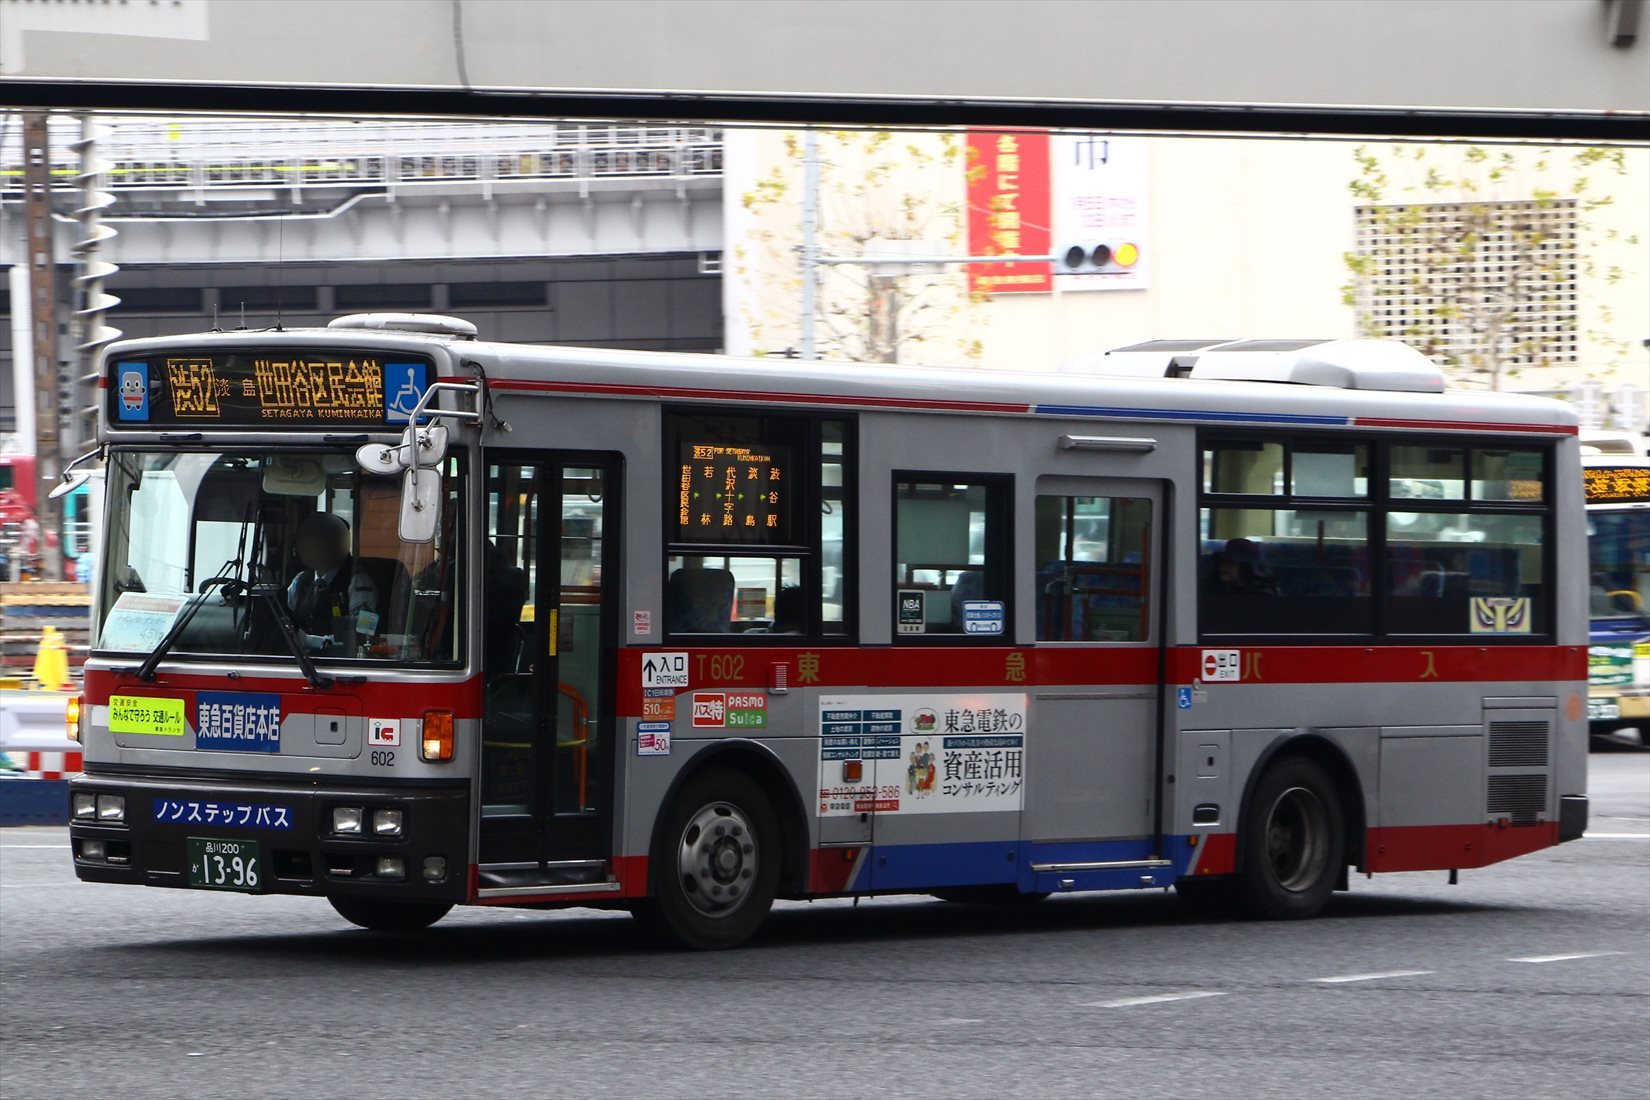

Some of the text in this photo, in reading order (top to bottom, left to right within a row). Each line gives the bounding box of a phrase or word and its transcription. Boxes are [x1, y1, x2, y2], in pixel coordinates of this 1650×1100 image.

[255, 359, 383, 408] 世田谷区民会館
[261, 409, 384, 418] SETAGAYA KUMINKAIKA
[722, 466, 737, 526] 代沢十字路
[902, 599, 920, 609] NBA
[660, 656, 684, 673] 入口
[656, 674, 687, 685] ENTRANCE
[112, 698, 138, 708] 交通安全
[728, 696, 764, 708] PASMO
[198, 702, 281, 742] 東急百貨店本店
[729, 712, 763, 725] Suica
[943, 708, 1023, 733] 東急電鉄の
[371, 751, 395, 766] 602
[943, 750, 1023, 781] 資産活用
[942, 779, 1023, 798] コンサルティング
[156, 802, 289, 827] ノンステップバス
